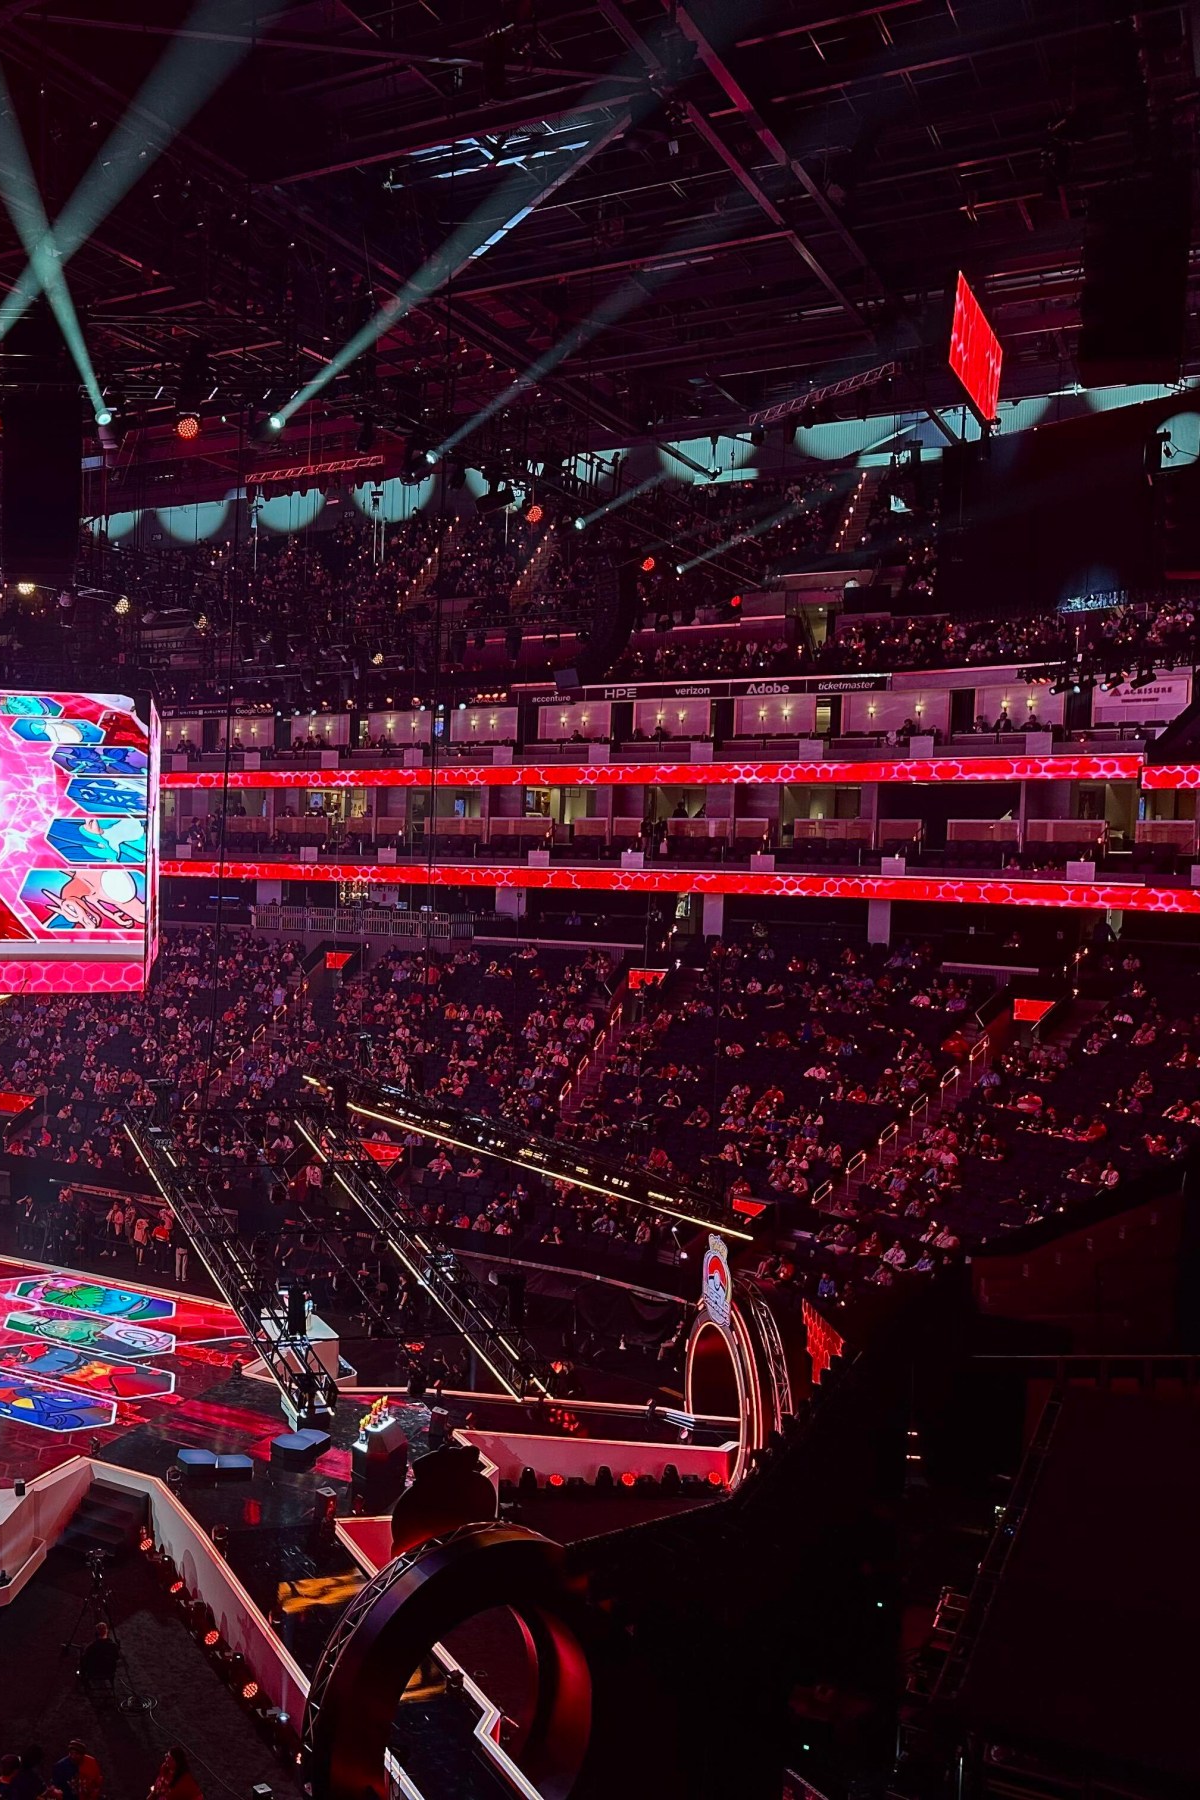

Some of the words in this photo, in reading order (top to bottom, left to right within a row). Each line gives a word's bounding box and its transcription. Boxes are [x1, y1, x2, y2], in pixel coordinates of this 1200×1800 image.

[746, 683, 790, 695] Adobe
[818, 681, 875, 690] ticketmaster
[604, 688, 637, 699] HPE
[675, 686, 710, 695] verizon
[532, 694, 571, 703] accenture
[235, 707, 256, 715] Google
[256, 706, 274, 714] Cloud
